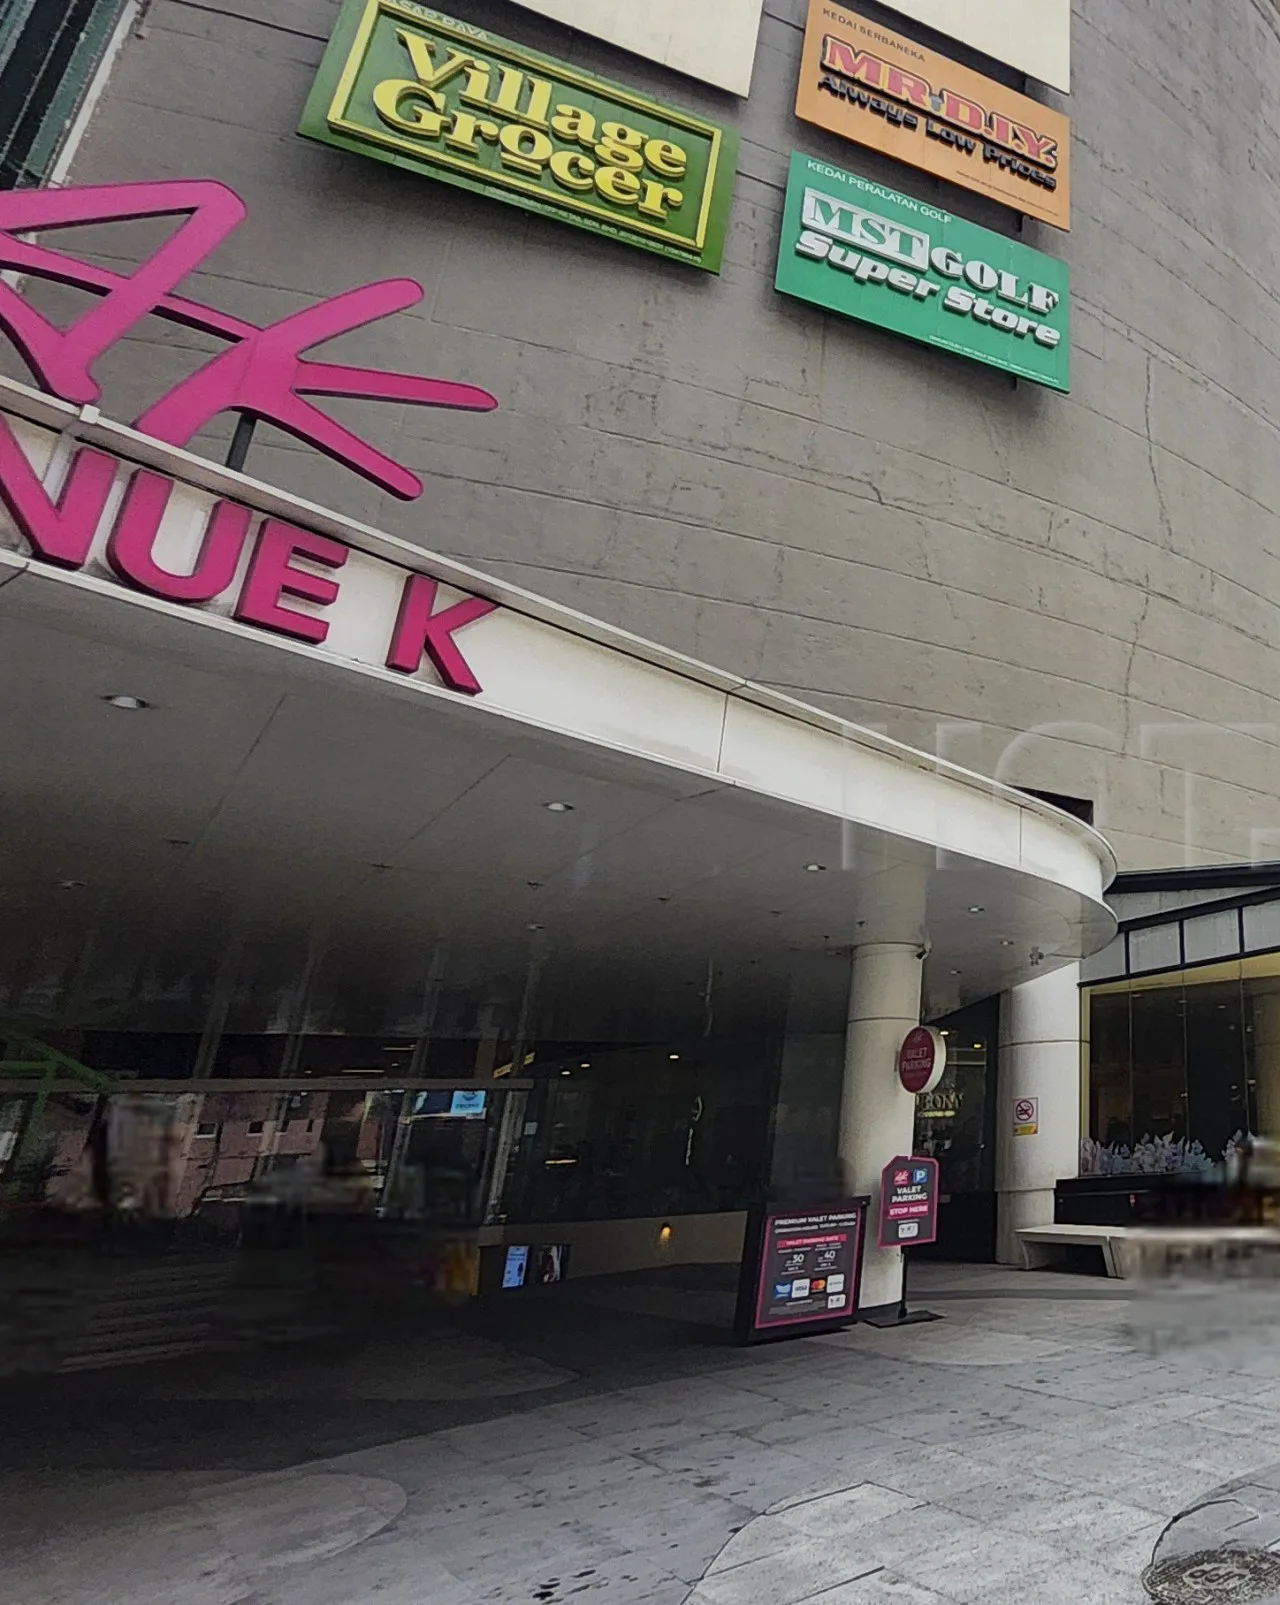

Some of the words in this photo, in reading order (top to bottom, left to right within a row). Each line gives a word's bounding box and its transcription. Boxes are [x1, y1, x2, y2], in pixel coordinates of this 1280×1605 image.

[822, 7, 858, 31] KEDAI
[858, 25, 926, 63] SERBANEKA
[372, 77, 683, 221] Grocer
[394, 26, 689, 179] Village
[818, 74, 918, 131] Always
[925, 119, 979, 157] Low
[982, 145, 1058, 192] Prices
[806, 158, 847, 184] KEDAI
[848, 175, 919, 214] PERALATAN
[919, 204, 953, 225] GOLF
[795, 230, 942, 300] Super
[943, 286, 1062, 348] Store
[808, 196, 926, 265] MST
[930, 246, 1061, 314] GOLF
[385, 573, 500, 696] K
[889, 1207, 909, 1216] STOP
[909, 1204, 929, 1213] HERE
[891, 1193, 928, 1203] PARKING
[897, 1185, 922, 1195] VALET
